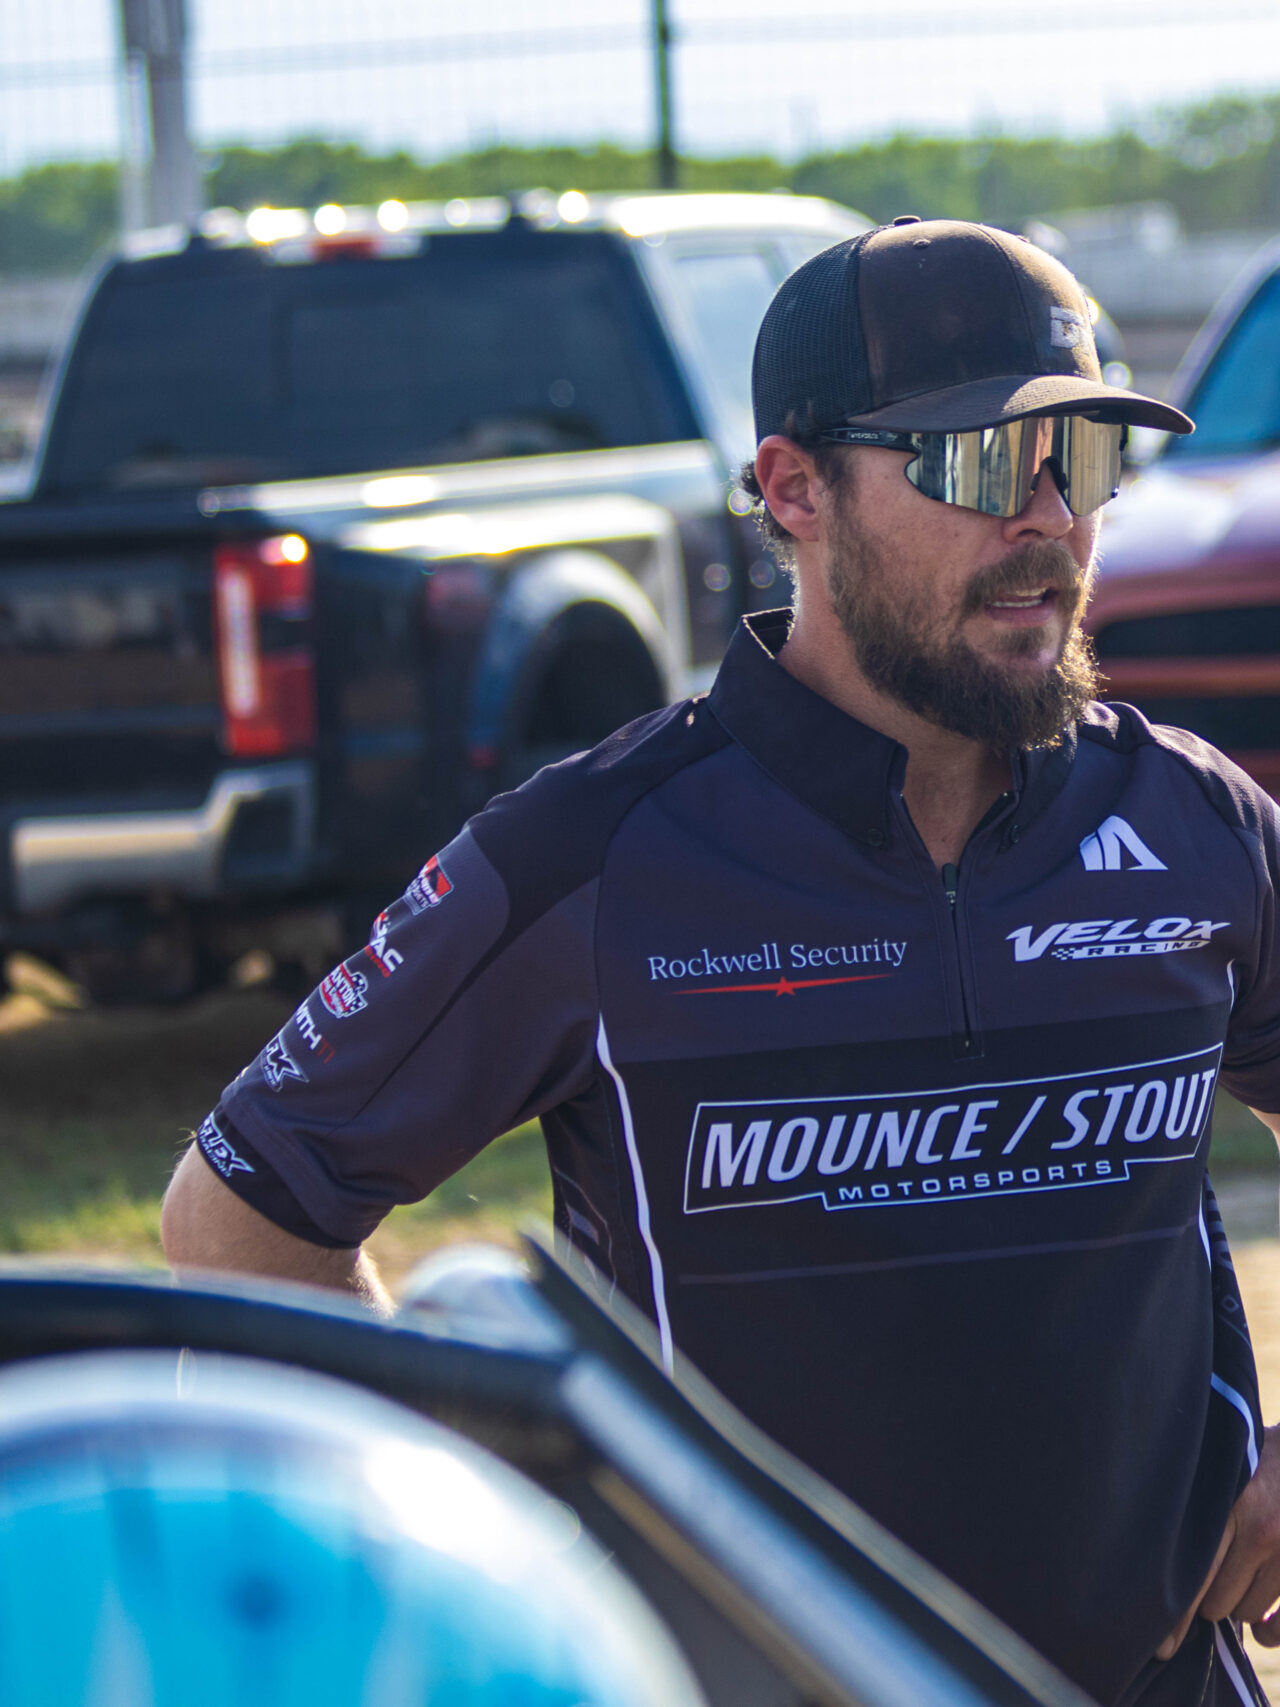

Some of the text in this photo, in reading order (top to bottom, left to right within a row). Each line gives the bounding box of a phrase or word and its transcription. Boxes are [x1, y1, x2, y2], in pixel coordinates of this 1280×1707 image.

[647, 938, 908, 981] Rockwell Security
[1005, 917, 1232, 962] VELOX
[1087, 940, 1202, 957] RACING
[700, 1100, 999, 1189] MOUNCE
[1051, 1068, 1216, 1150] STOUT
[839, 1159, 1112, 1201] MOTORSPORTS
